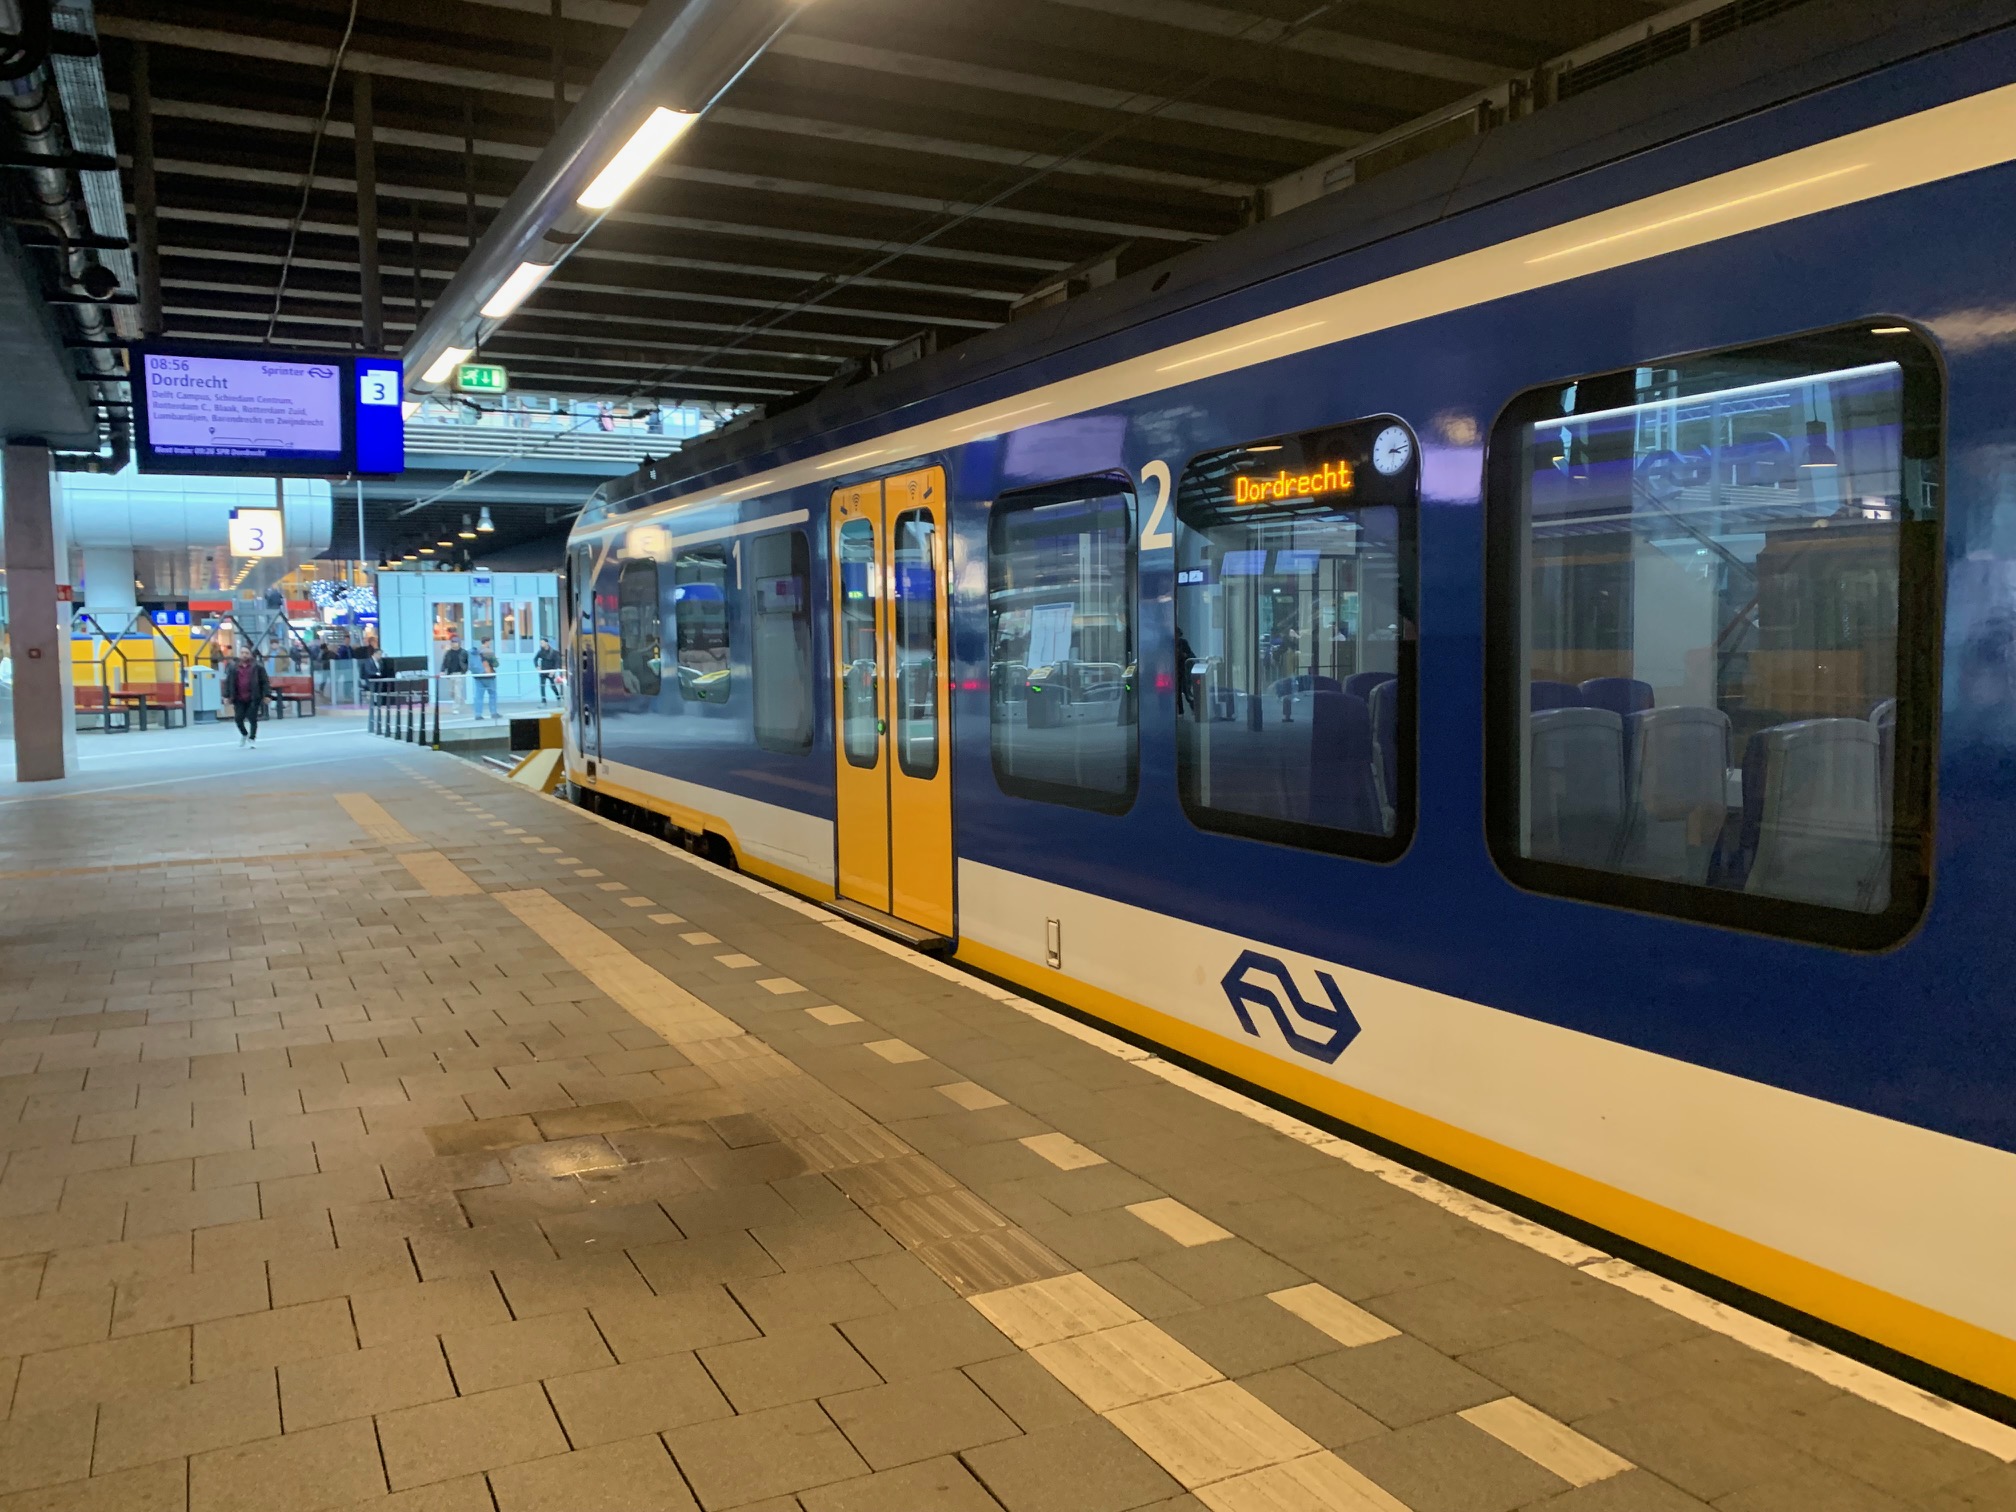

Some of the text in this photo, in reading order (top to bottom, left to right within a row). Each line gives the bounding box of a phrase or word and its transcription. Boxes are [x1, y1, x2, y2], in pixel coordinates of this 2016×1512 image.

[151, 358, 190, 371] 08:56
[261, 366, 305, 376] Sprinter
[152, 373, 228, 389] Dordrecht
[373, 383, 385, 401] 3
[1236, 460, 1352, 506] Dordrecht
[1140, 459, 1173, 551] 2
[249, 528, 265, 552] 3
[731, 540, 742, 590] 1
